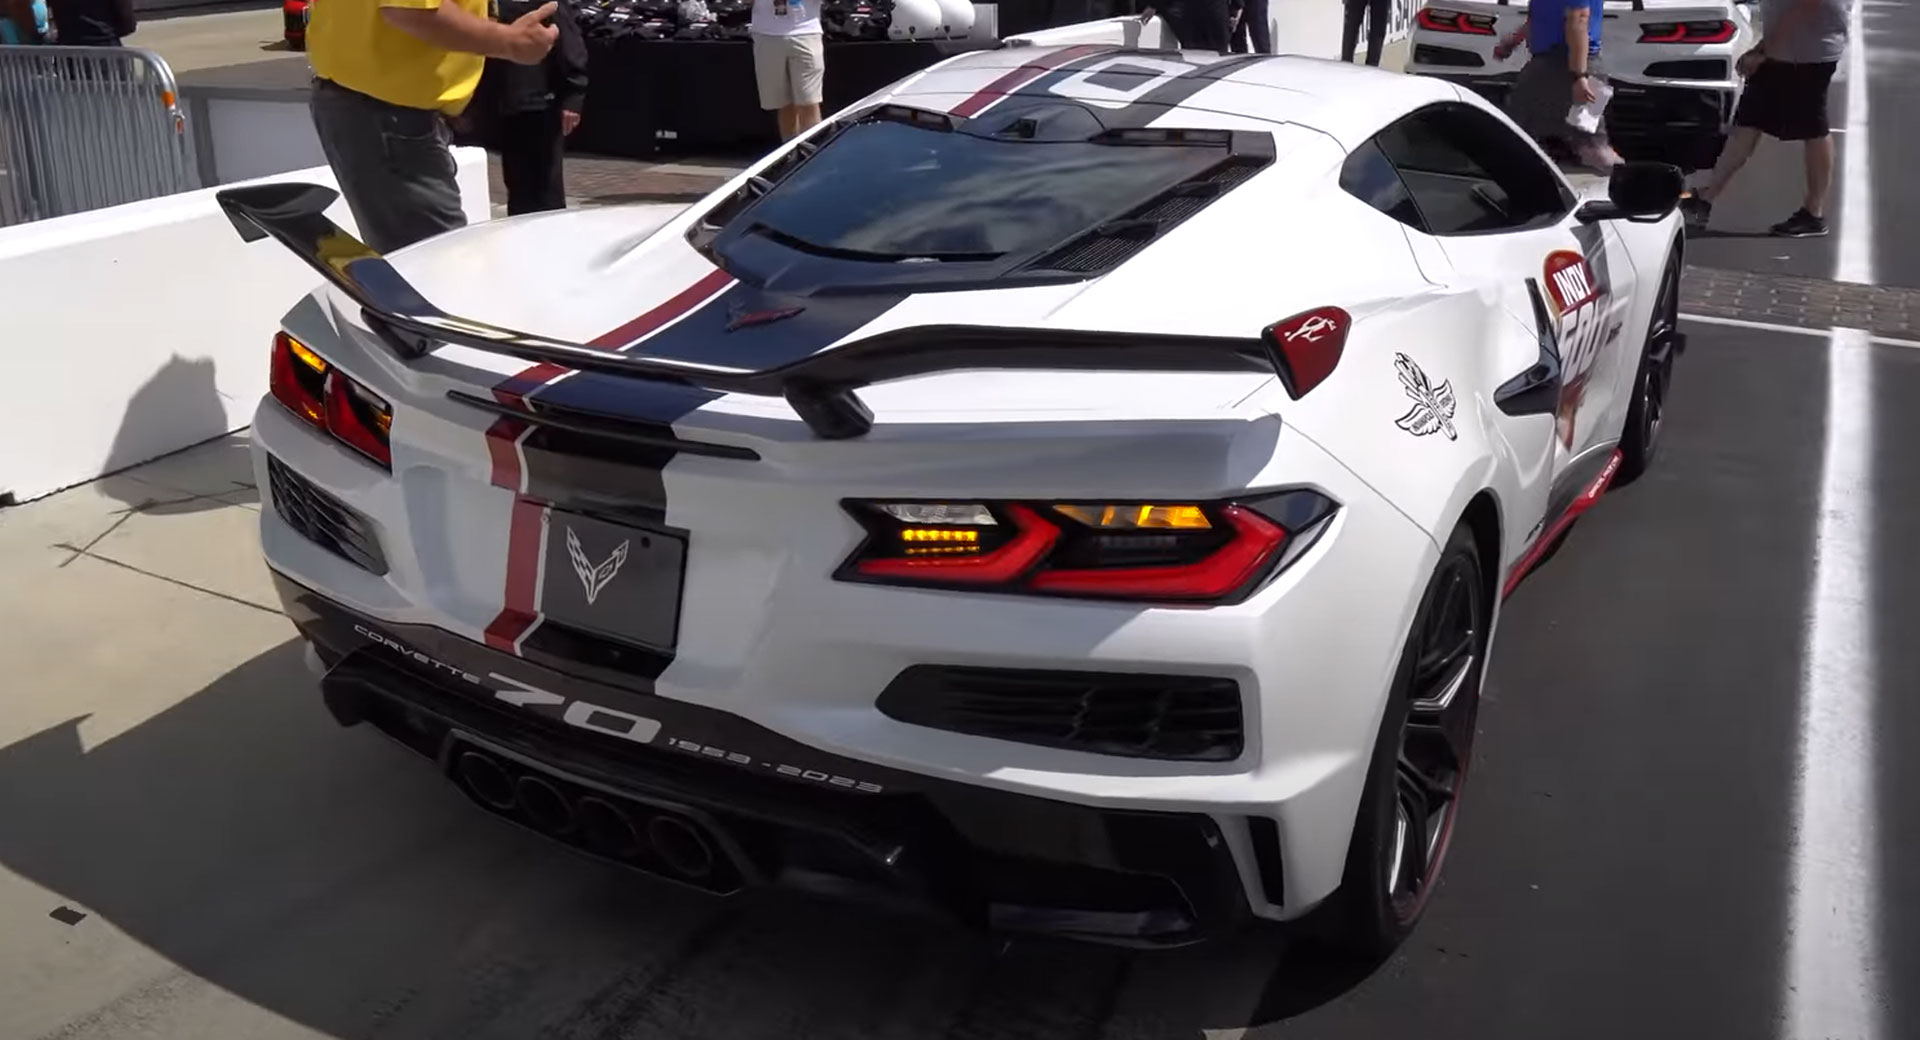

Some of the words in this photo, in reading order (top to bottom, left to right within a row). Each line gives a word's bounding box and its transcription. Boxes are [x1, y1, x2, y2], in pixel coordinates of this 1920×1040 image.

[1552, 262, 1591, 307] INDY
[354, 624, 480, 684] CORVETTE
[488, 672, 662, 744] 70
[668, 737, 751, 764] 1953
[776, 764, 883, 793] 2023
